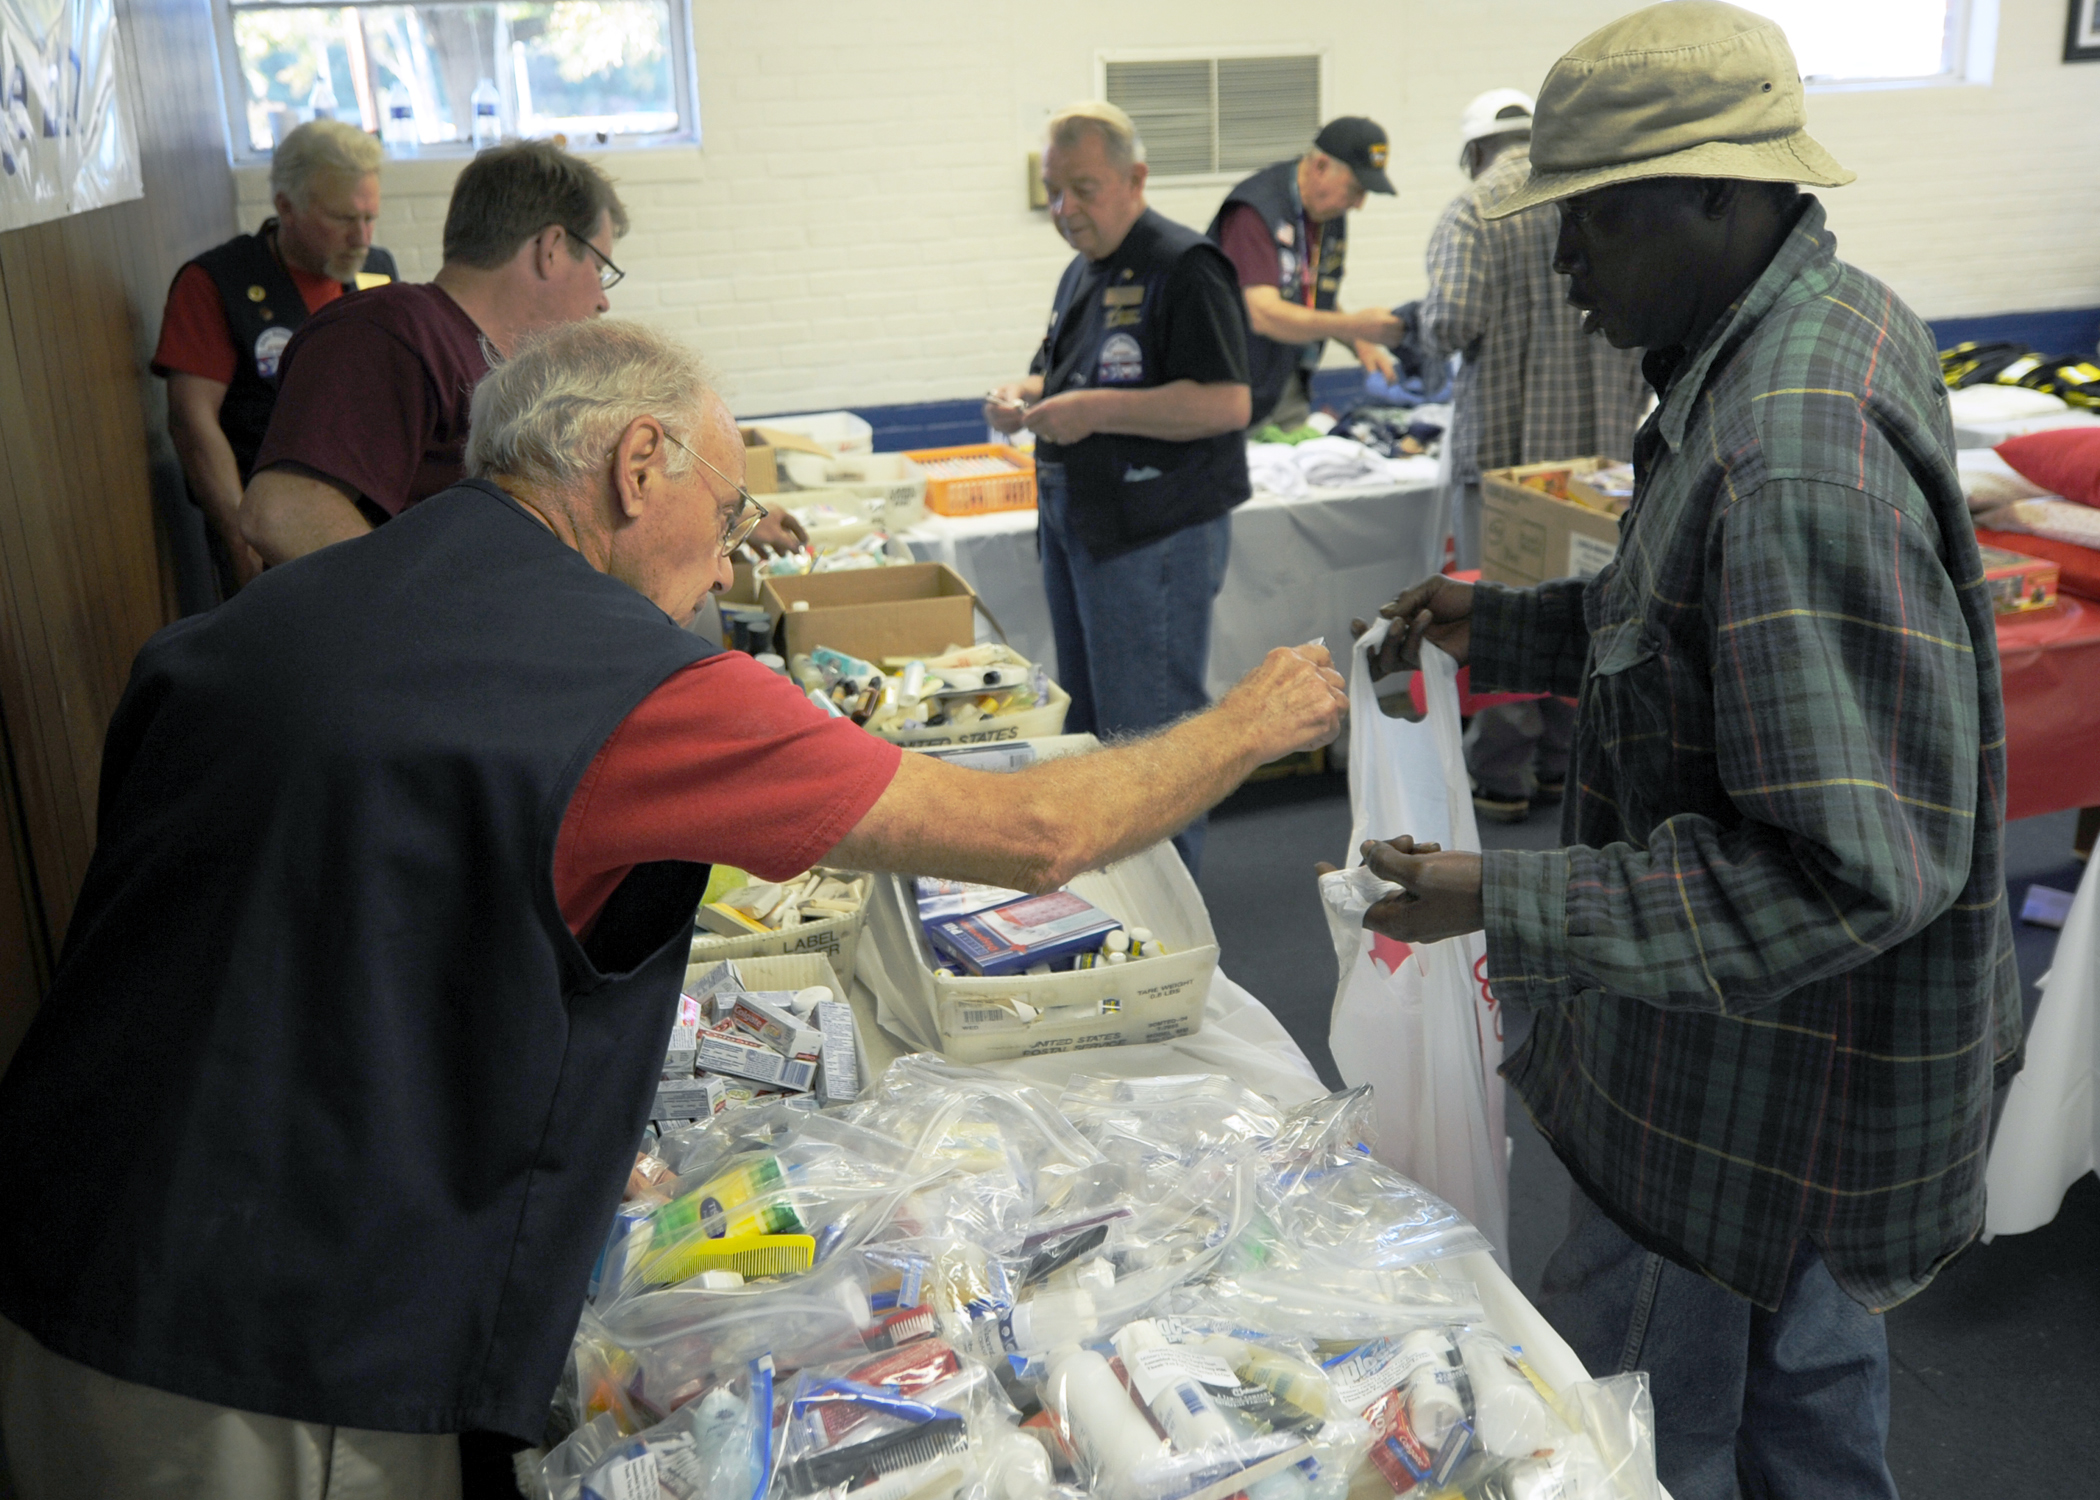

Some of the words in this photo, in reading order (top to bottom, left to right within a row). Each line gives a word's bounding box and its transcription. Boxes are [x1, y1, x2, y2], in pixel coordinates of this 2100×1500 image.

[959, 726, 1019, 744] STATES
[783, 931, 839, 954] LABEL
[1137, 987, 1158, 996] TARE
[1161, 979, 1194, 991] WEIGHT
[1164, 988, 1181, 997] LBS
[733, 1004, 764, 1028] Colgate
[1074, 1039, 1128, 1051] SERVICE
[1077, 1032, 1121, 1043] STATES
[1400, 1436, 1425, 1466] Colgate
